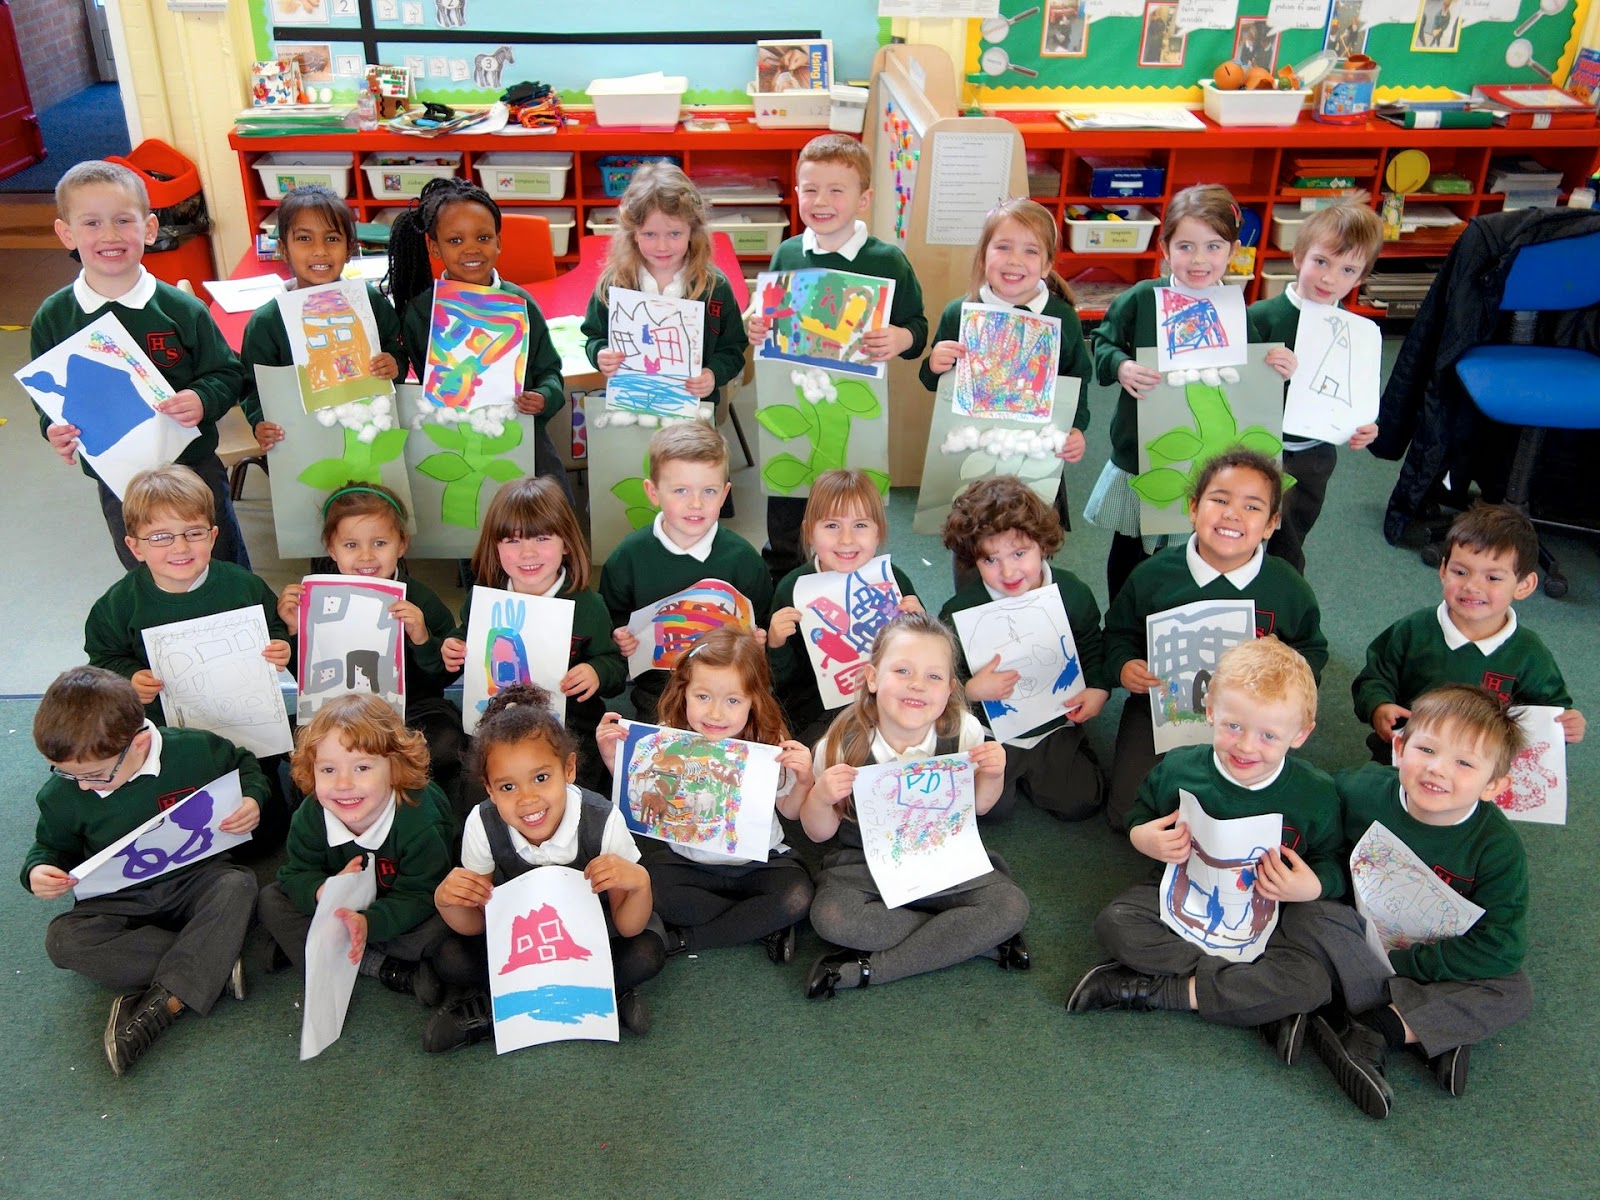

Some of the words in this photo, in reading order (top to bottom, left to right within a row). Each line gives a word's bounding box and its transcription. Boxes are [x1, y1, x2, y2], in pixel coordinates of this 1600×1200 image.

[340, 0, 349, 12] 2
[346, 60, 352, 70] 1
[485, 58, 492, 69] 3
[810, 51, 822, 79] Using
